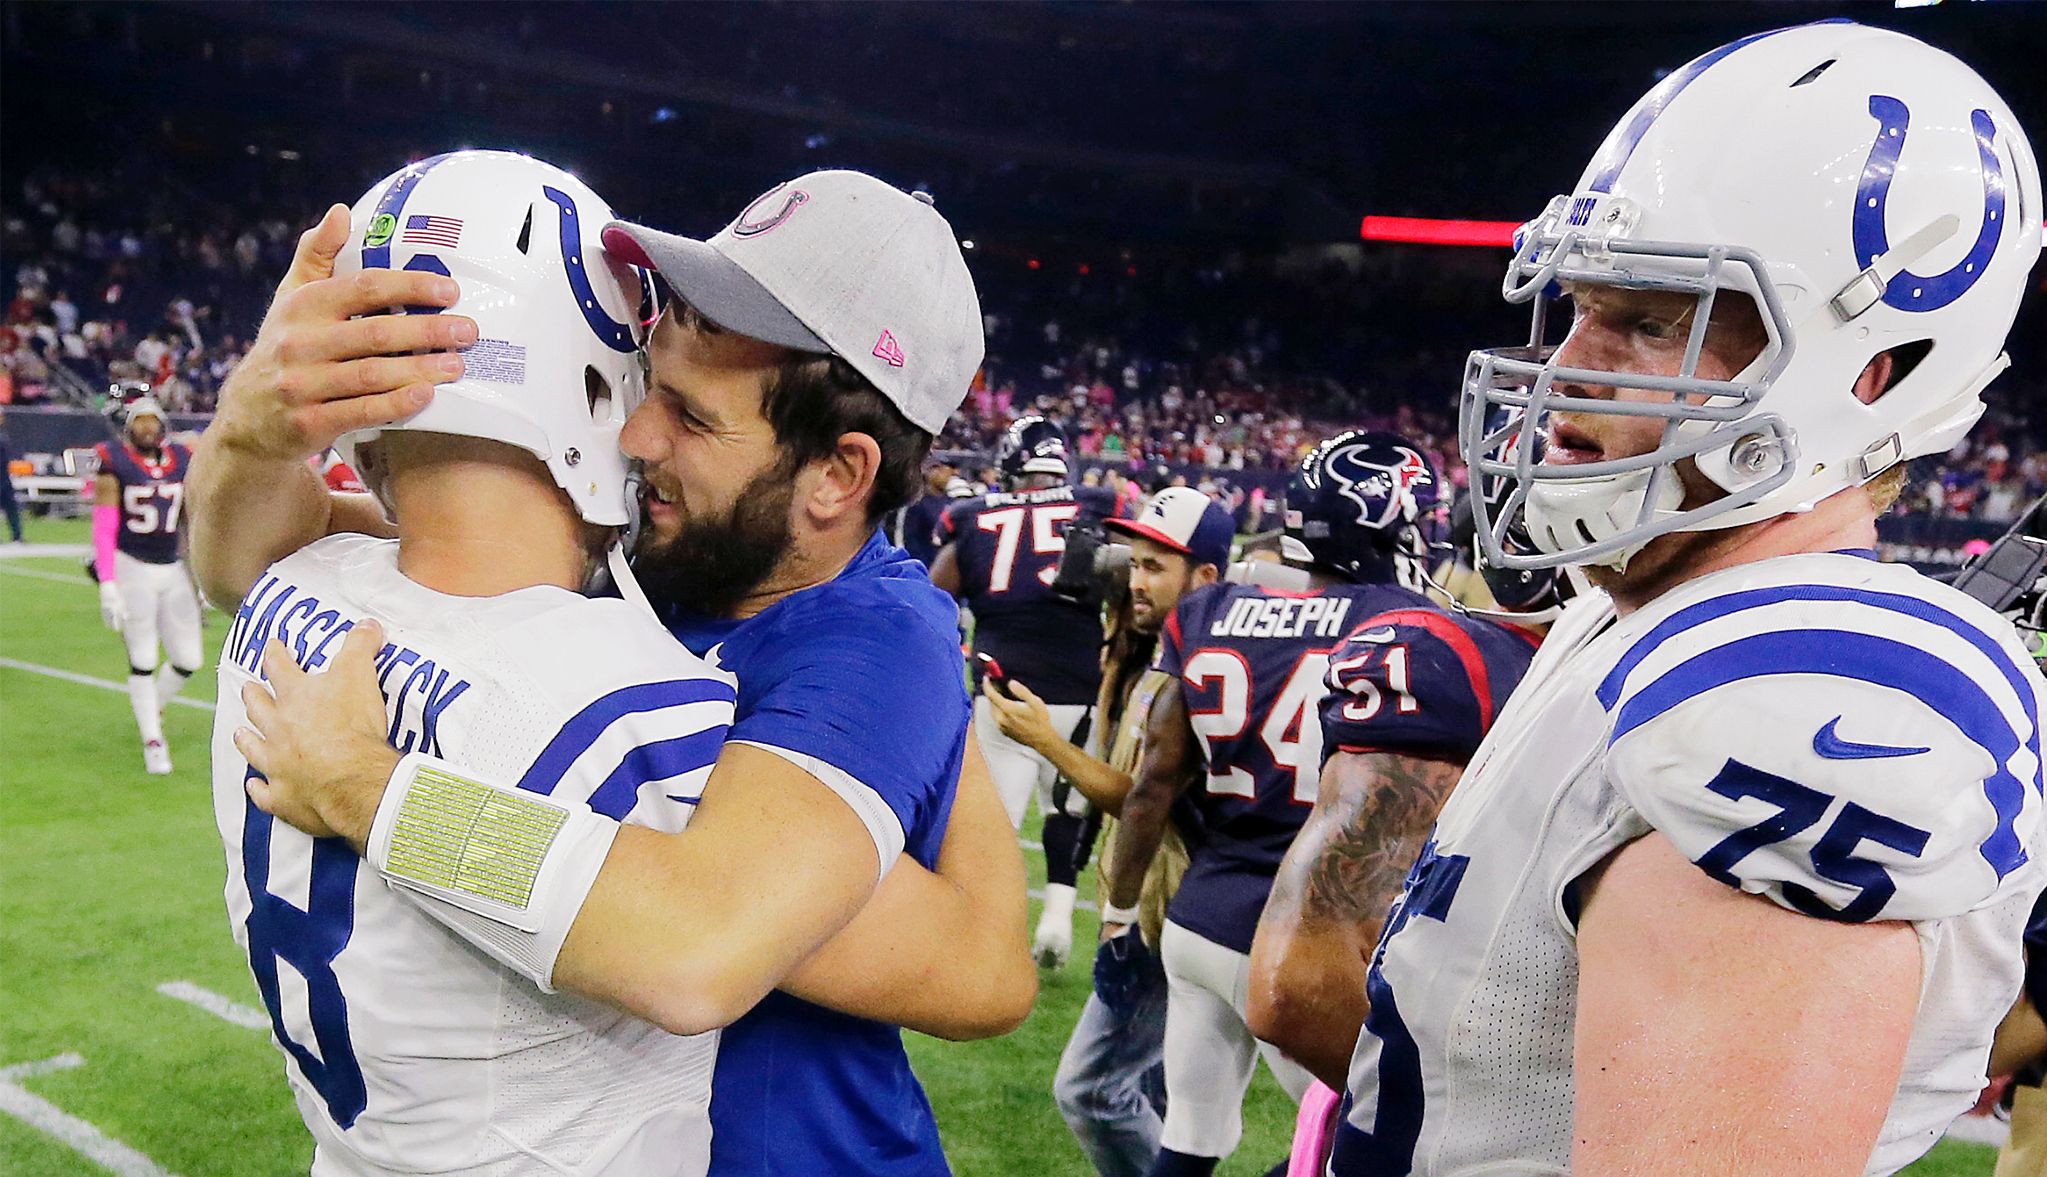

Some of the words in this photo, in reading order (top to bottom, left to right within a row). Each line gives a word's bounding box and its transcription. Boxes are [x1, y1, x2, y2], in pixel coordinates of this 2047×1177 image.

[123, 482, 184, 534] 57
[976, 501, 1081, 595] 75
[228, 571, 471, 760] HASSEECK
[1210, 597, 1352, 638] JOSEPH
[1183, 647, 1334, 807] 24
[1329, 642, 1421, 721] 51
[1690, 756, 1932, 925] 75
[242, 761, 368, 1132] 8
